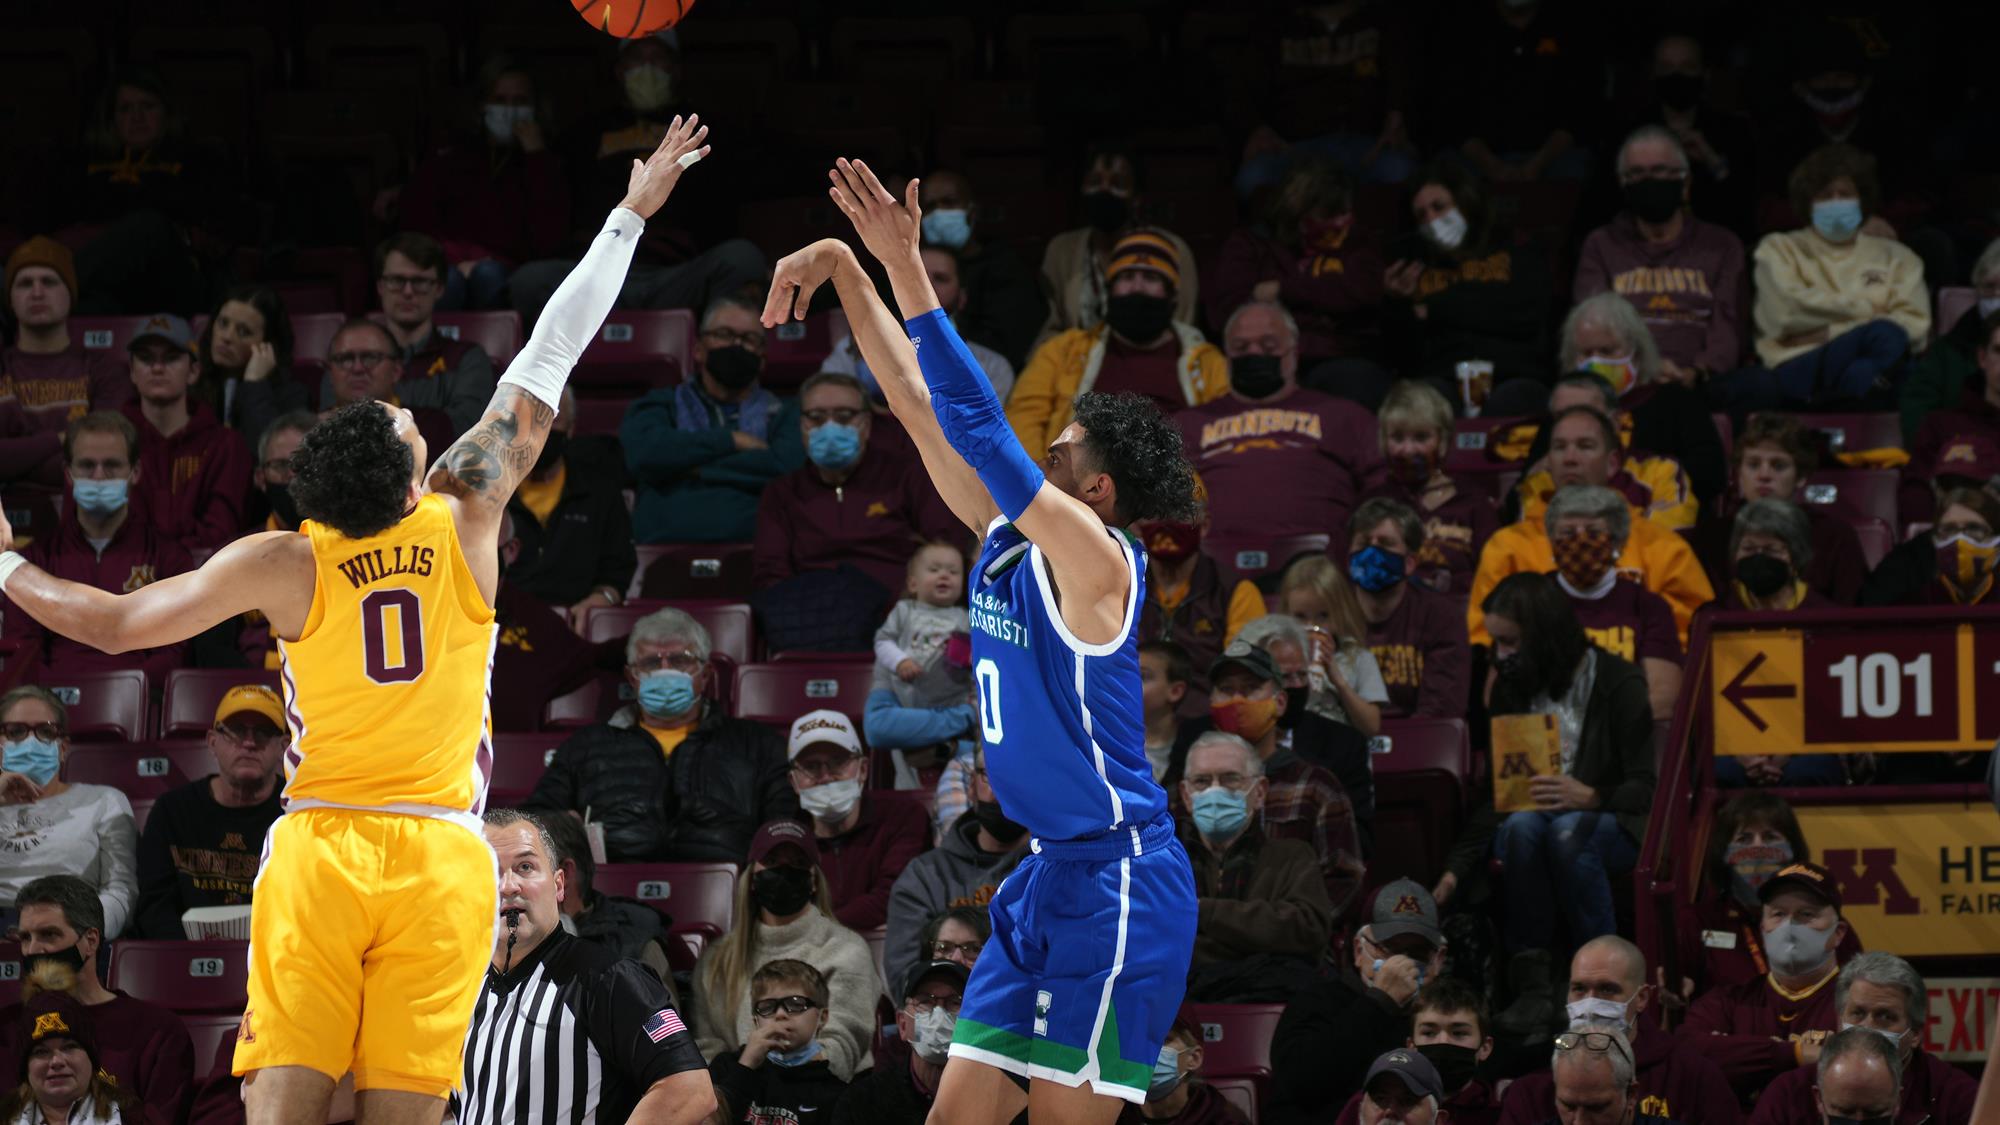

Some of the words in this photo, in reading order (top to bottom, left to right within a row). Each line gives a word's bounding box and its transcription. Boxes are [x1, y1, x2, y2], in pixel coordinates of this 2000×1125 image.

[337, 545, 434, 589] WILLIS
[361, 587, 425, 685] 0
[976, 657, 1004, 745] 0
[1828, 652, 1934, 718] 101
[146, 758, 163, 773] 18
[644, 884, 662, 898] 21
[199, 960, 216, 975] 19
